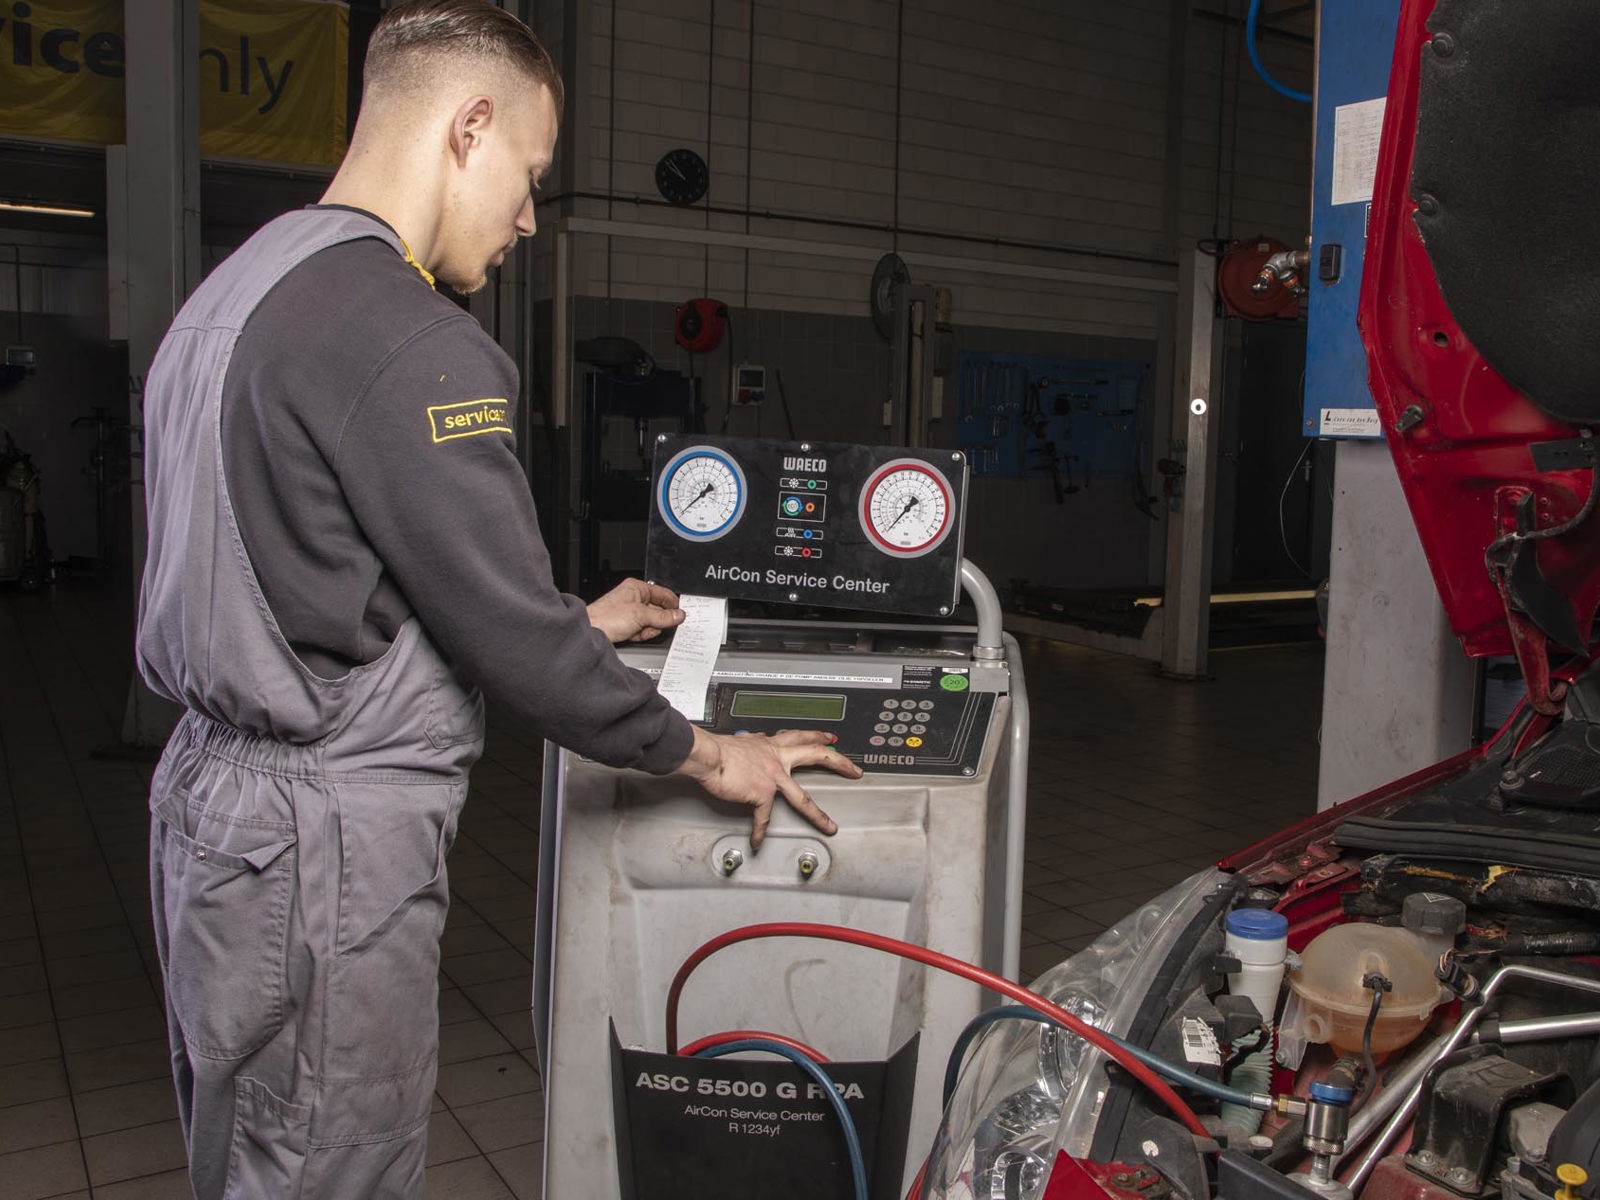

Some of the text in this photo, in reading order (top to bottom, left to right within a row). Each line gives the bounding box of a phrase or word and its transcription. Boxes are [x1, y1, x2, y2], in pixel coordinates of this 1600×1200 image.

[0, 2, 294, 114] ice nly
[783, 456, 827, 473] WAECO
[705, 564, 890, 594] AirCon Service Center
[863, 753, 915, 766] WAECO
[635, 1072, 690, 1093] ASC
[696, 1078, 767, 1098] 5500
[776, 1082, 797, 1100] G
[684, 1105, 826, 1122] AirCon Service Center
[728, 1123, 782, 1137] R 1234yf
